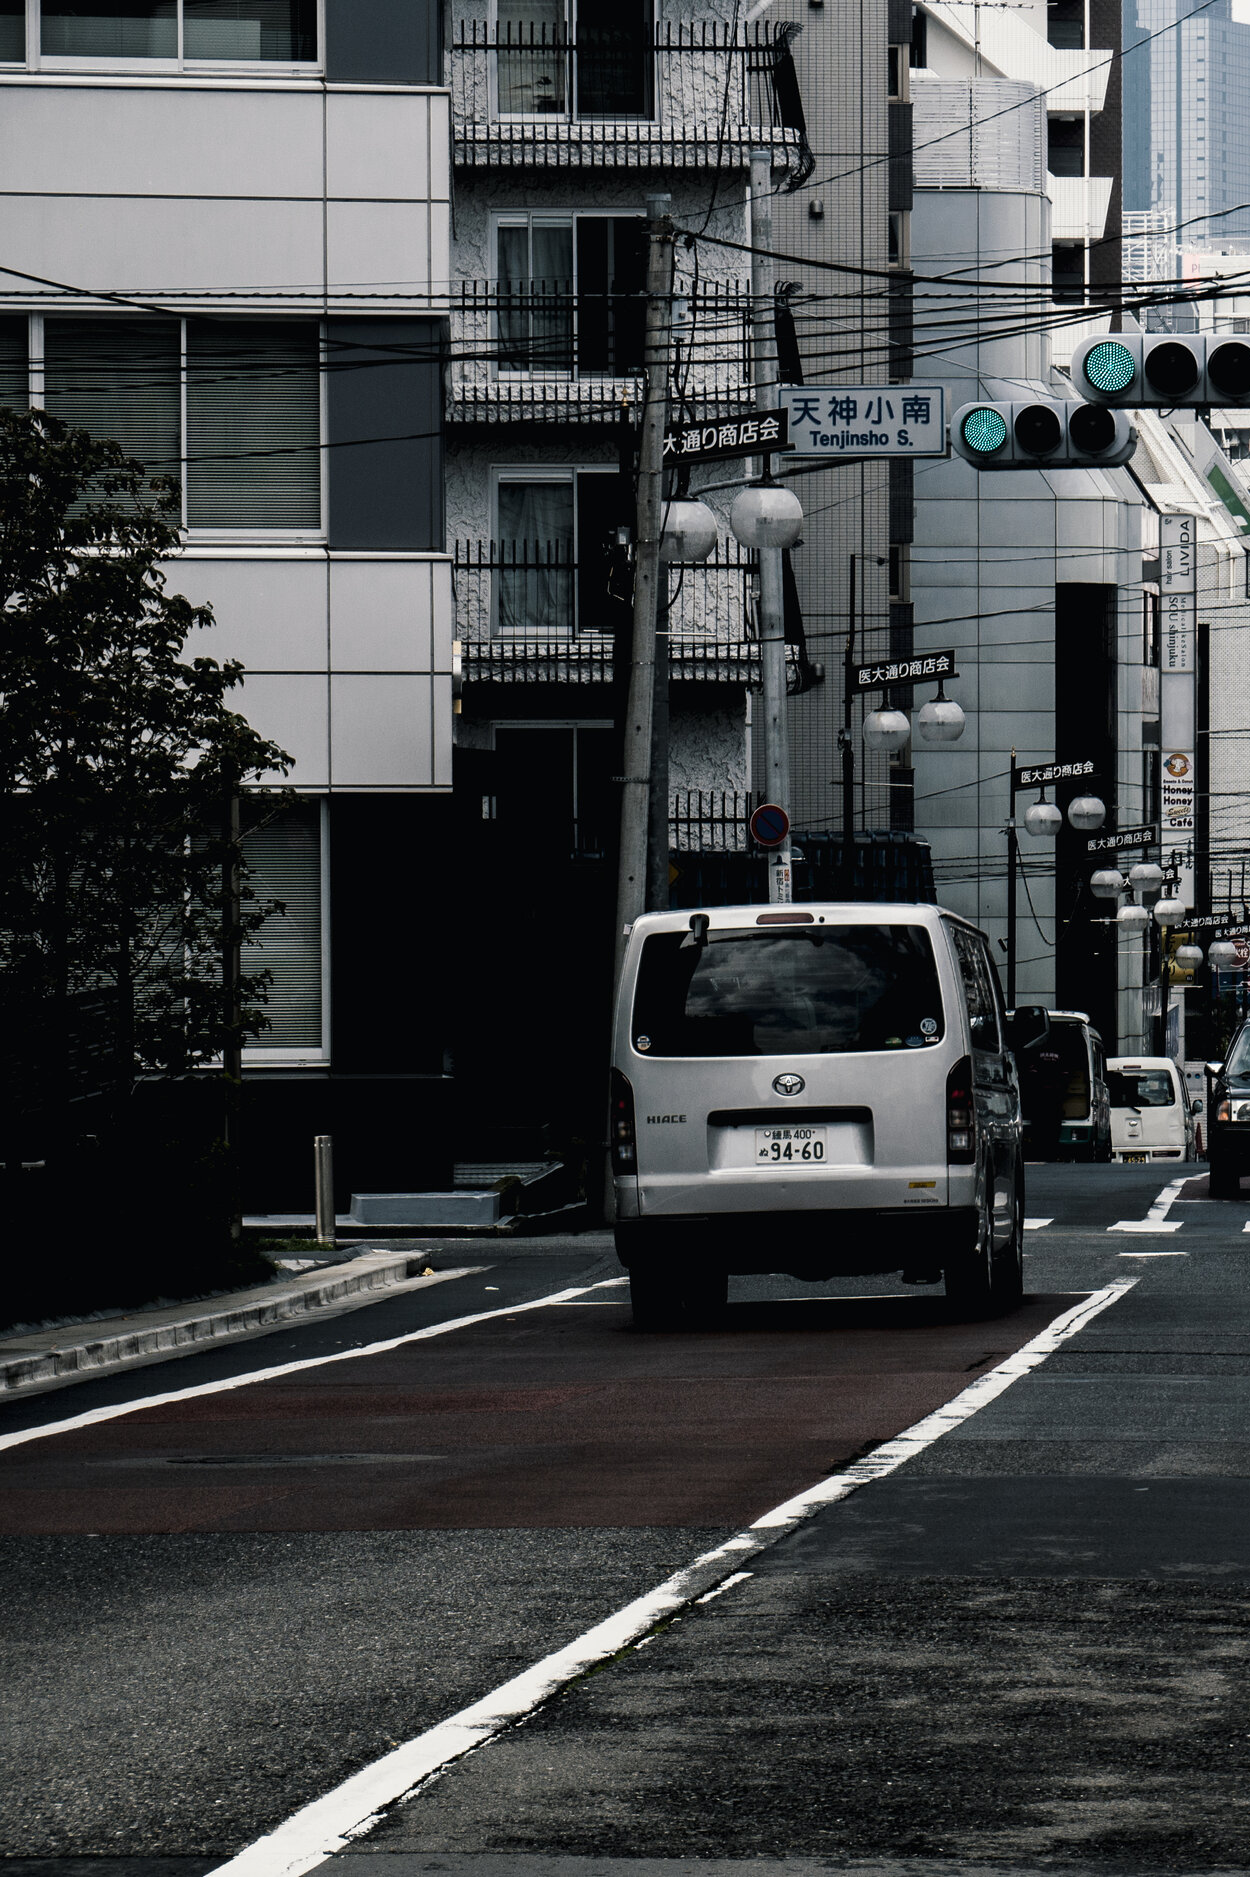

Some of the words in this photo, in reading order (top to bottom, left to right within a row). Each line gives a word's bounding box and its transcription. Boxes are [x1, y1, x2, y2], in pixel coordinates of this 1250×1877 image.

[791, 395, 932, 427] 天神小南
[809, 429, 889, 449] Tenjinsho
[897, 429, 914, 446] S.
[1180, 520, 1190, 577] LIVIDA
[1167, 625, 1178, 667] shinjuku
[858, 656, 950, 684] 医大通り商店会
[1021, 761, 1095, 784] 医大通り商店会
[1163, 785, 1192, 795] Honey
[1163, 796, 1192, 806] Honey
[1170, 817, 1192, 826] Café
[1088, 830, 1153, 851] 医大通り商店会
[647, 1114, 687, 1125] HIACE
[794, 1129, 811, 1139] 400
[771, 1141, 824, 1160] 94-60
